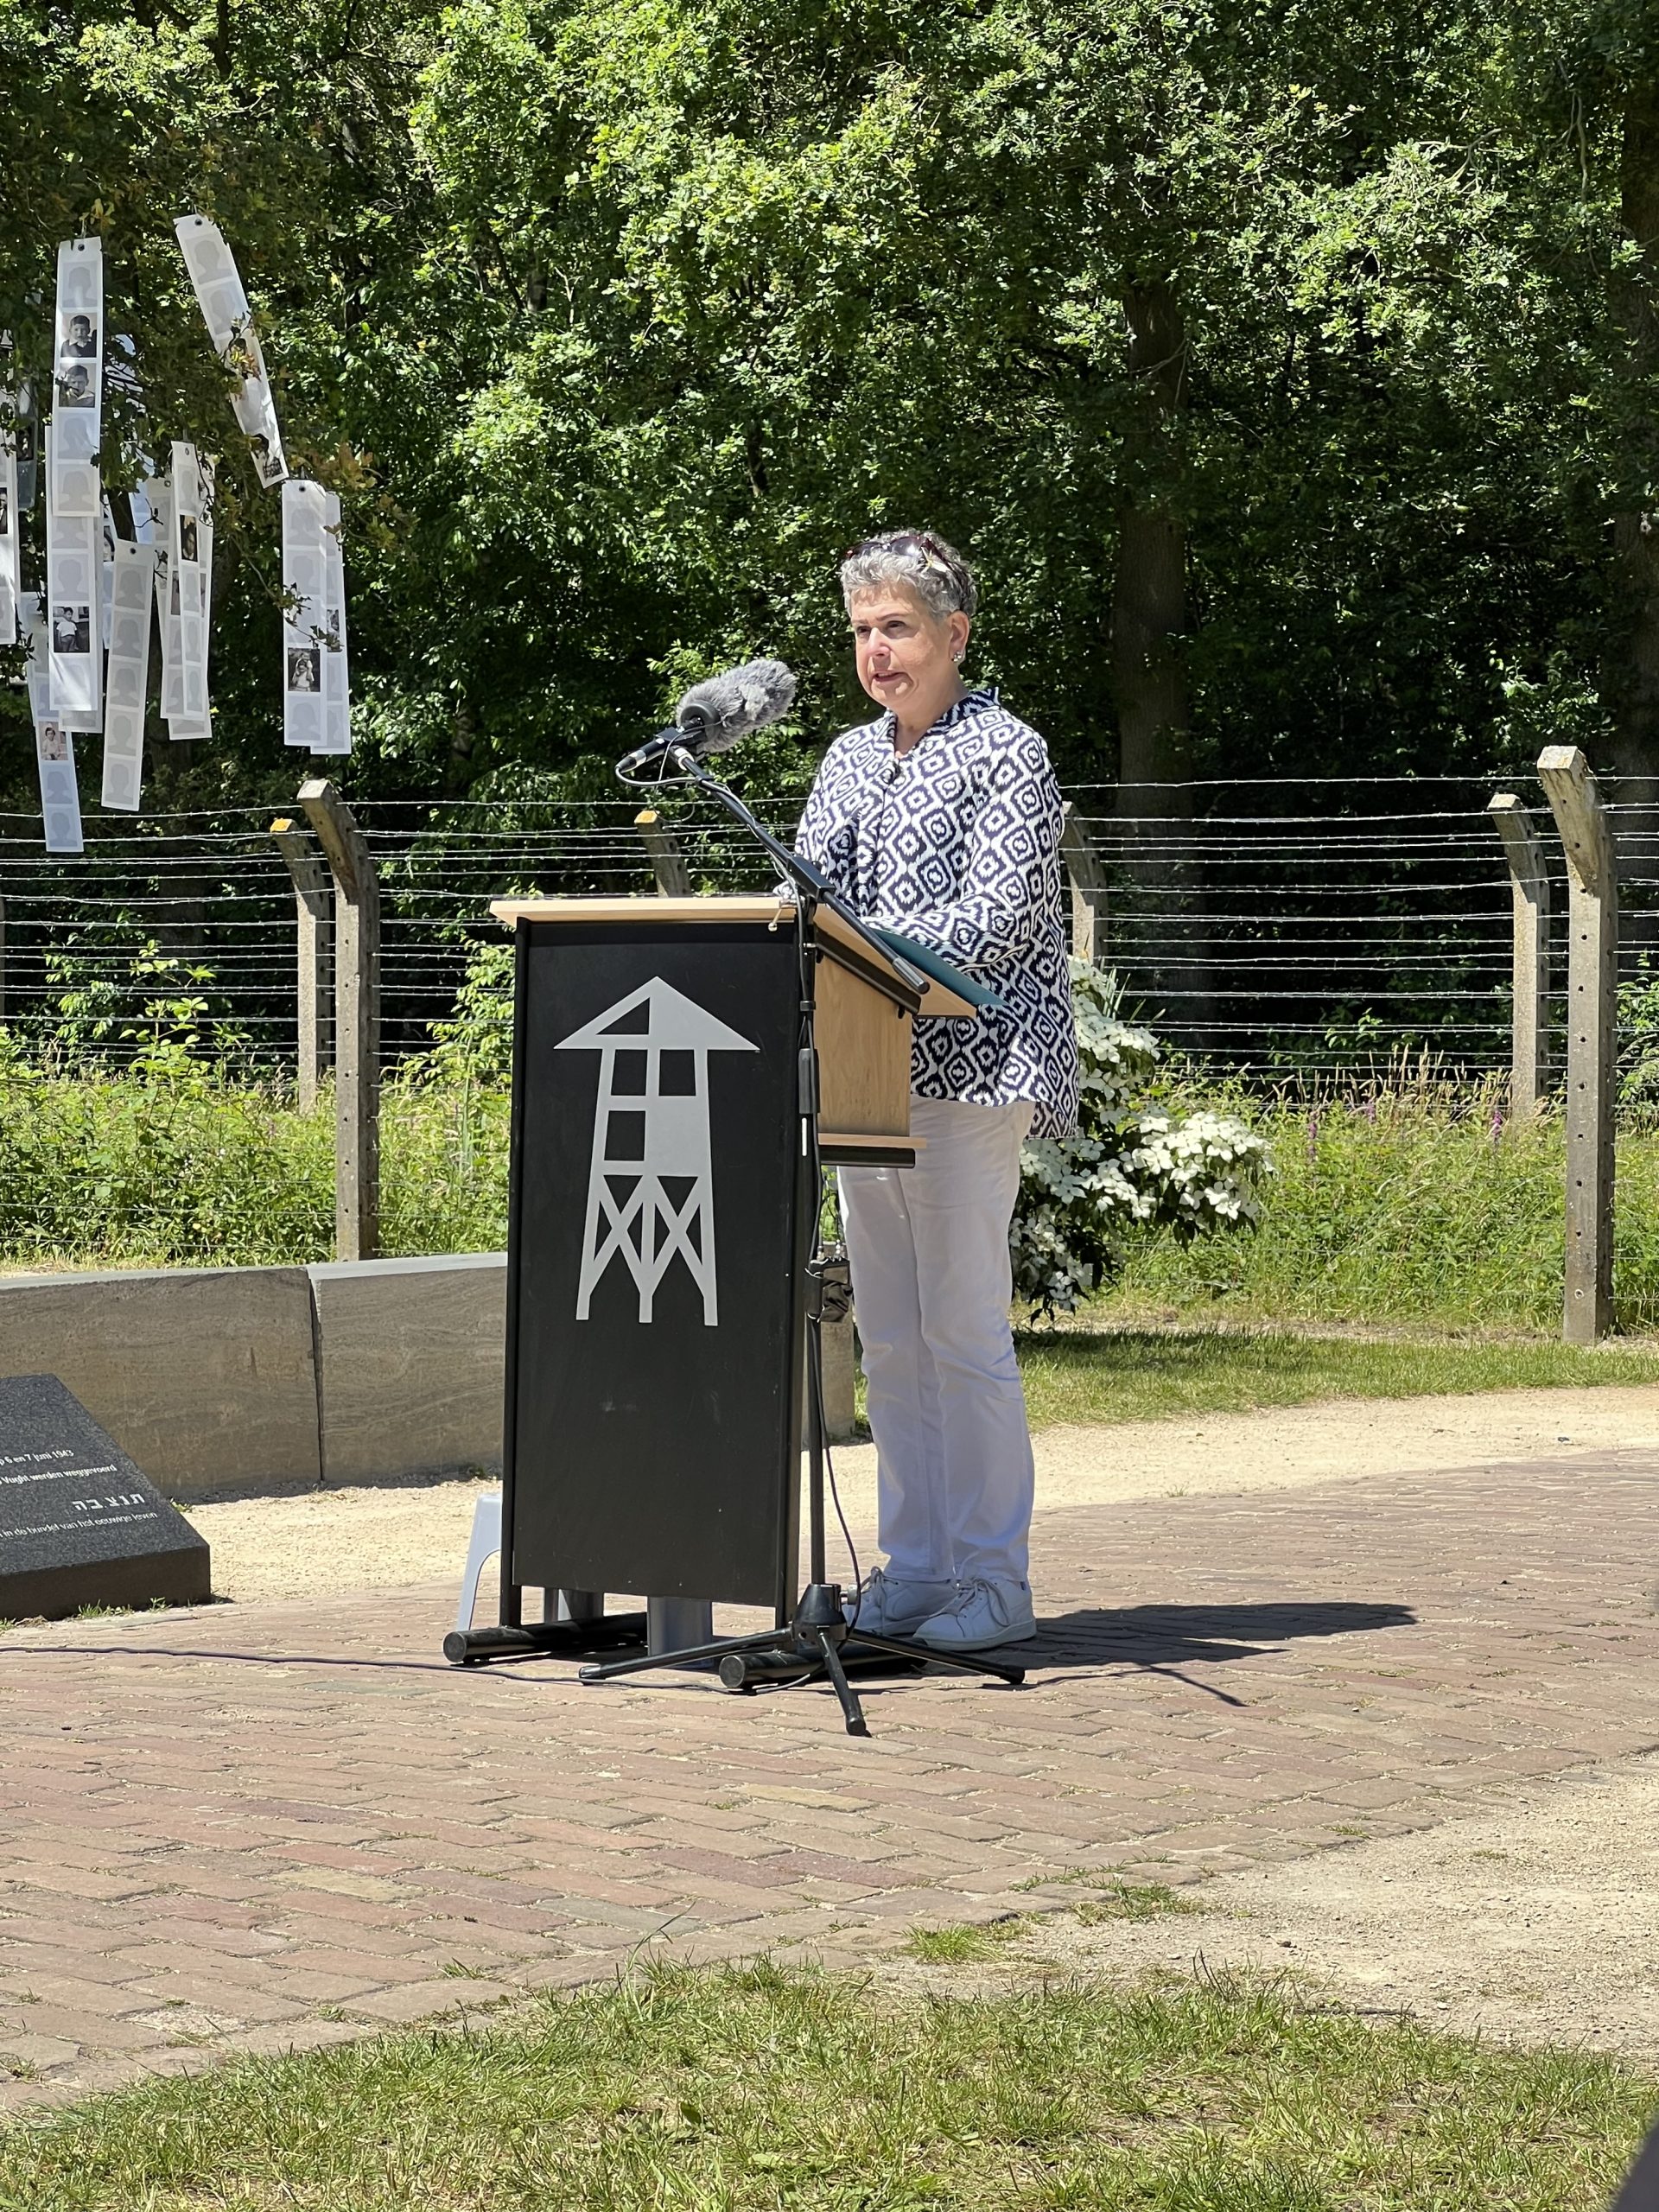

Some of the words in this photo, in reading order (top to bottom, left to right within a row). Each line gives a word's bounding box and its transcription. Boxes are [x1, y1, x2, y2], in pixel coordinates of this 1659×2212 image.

[32, 1452, 53, 1462] juni
[52, 1449, 74, 1459] 1943
[1, 1475, 31, 1484] Vught
[29, 1471, 64, 1481] werden
[63, 1464, 118, 1478] weggevoerd
[60, 1522, 79, 1530] van
[77, 1519, 95, 1528] het
[131, 1512, 158, 1521] leven
